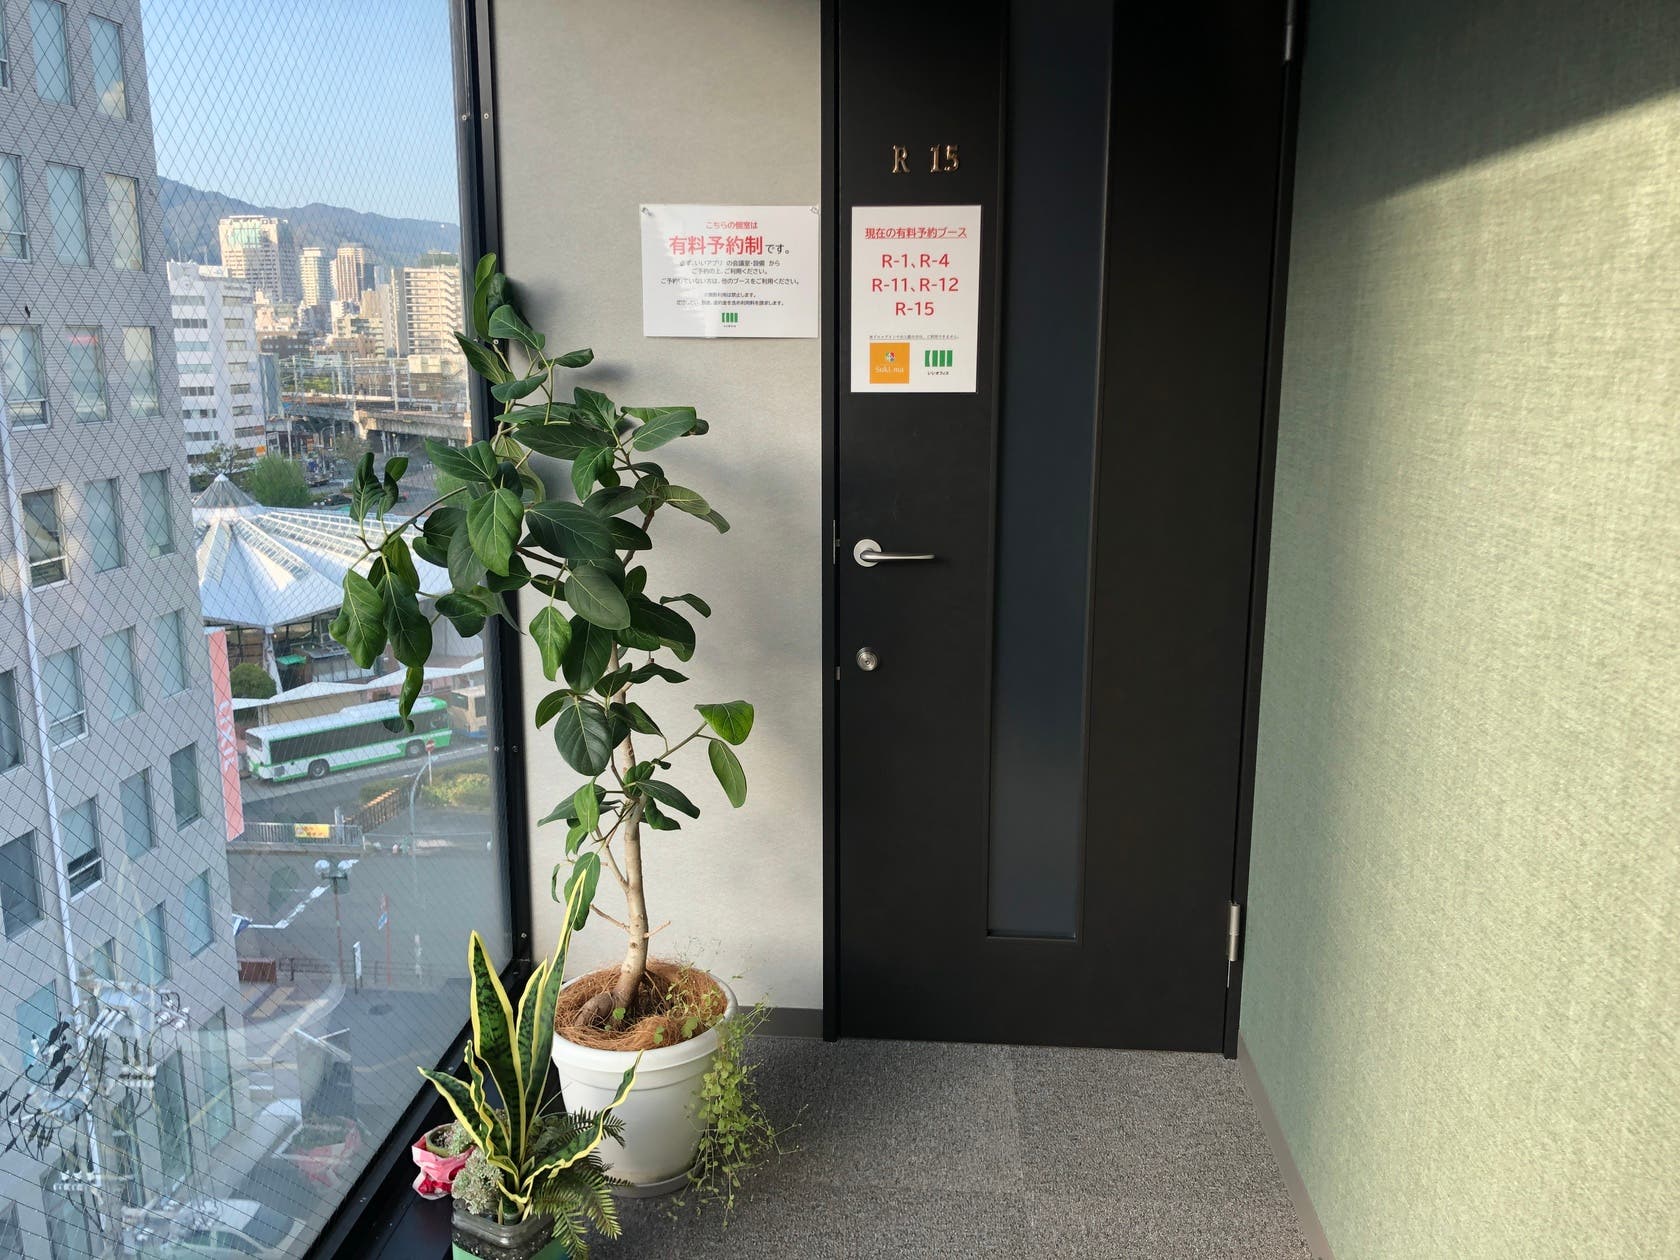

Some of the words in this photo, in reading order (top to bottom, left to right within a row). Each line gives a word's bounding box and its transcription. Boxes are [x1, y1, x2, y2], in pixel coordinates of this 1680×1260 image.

[891, 145, 910, 173] R
[930, 144, 960, 172] 15
[705, 221, 759, 230] こちらの個室は
[865, 227, 967, 239] 現在の有料予約ブース
[895, 302, 935, 316] R-15
